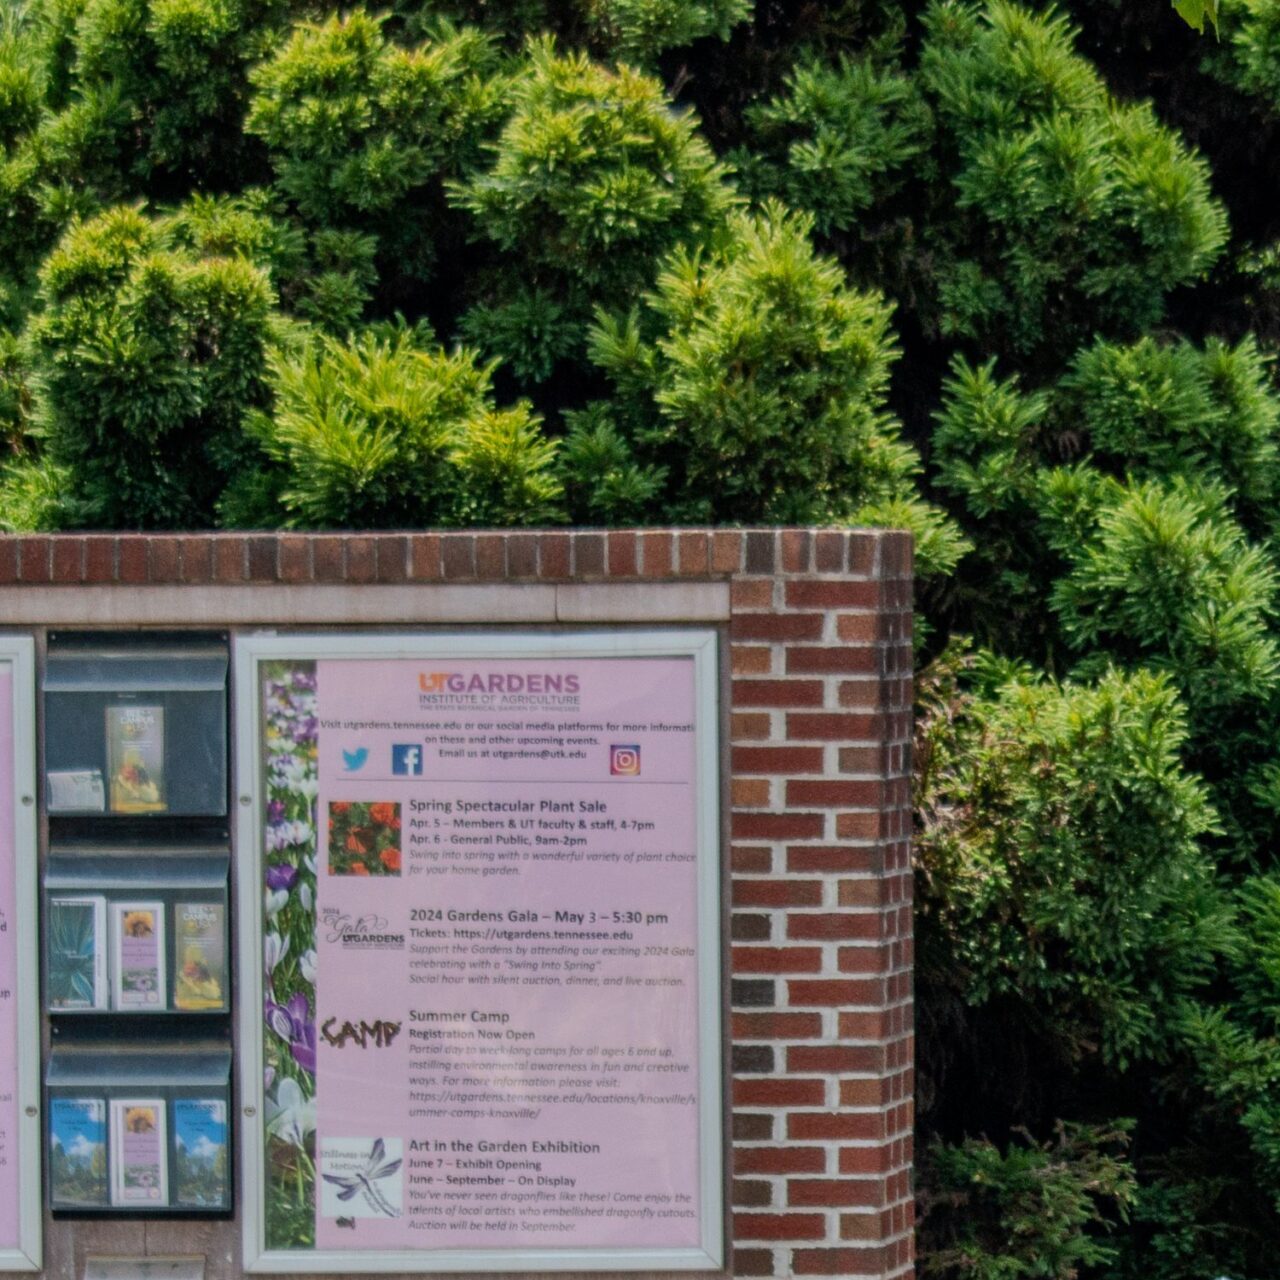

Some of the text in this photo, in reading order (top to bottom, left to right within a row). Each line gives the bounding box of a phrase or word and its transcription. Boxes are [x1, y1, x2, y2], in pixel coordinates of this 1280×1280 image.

[419, 692, 581, 705] INSTITUTE OF AGRICULTURE
[321, 720, 342, 729] Visit
[343, 721, 462, 730] utgardens.tennessee.edu
[464, 722, 475, 730] or
[496, 721, 524, 731] social
[525, 722, 556, 731] media
[557, 722, 604, 732] platforms
[605, 722, 620, 732] for
[622, 724, 648, 732] more
[425, 736, 438, 744] on
[439, 735, 466, 744] these
[468, 735, 487, 744] and
[488, 736, 515, 744] other
[517, 737, 565, 746] upcoming
[438, 749, 587, 759] Email us at utgardens@utk.edu
[409, 799, 607, 814] Spring Spectacular Plant Sale
[434, 818, 441, 828] 5
[452, 819, 505, 829] Members
[508, 819, 517, 829] &
[519, 819, 535, 829] UT
[538, 819, 576, 830] faculty
[578, 819, 587, 829] &
[590, 820, 617, 830] staff,
[620, 820, 655, 830] 4-7pm
[409, 834, 588, 846] Apr. 6 General Public, 9am-2pm
[410, 849, 440, 861] Swing
[441, 851, 462, 860] into
[463, 851, 496, 862] spring
[497, 850, 521, 860] with
[521, 852, 531, 861] a
[531, 851, 585, 861] wonderful
[586, 852, 622, 862] variety
[623, 851, 636, 863] of
[637, 852, 663, 862] plant
[410, 909, 669, 925] 2024 Gardens Gala May 3 5:30 pm
[453, 929, 634, 940] https://utgardens.tennessee.edu
[409, 944, 450, 955] Support
[451, 943, 470, 954] the
[470, 944, 513, 954] Gardens
[515, 945, 529, 956] by
[530, 945, 580, 956] attending
[581, 947, 601, 956] our
[601, 946, 642, 957] exciting
[642, 946, 670, 956] 2024
[671, 946, 696, 957] Gala
[409, 960, 467, 969] celebrating
[468, 959, 492, 969] with
[492, 960, 501, 970] a
[540, 961, 562, 970] Into
[409, 974, 685, 987] Social hour with silent auction, dinner, and live auction.
[409, 1010, 510, 1023] Summer Camp
[320, 1016, 402, 1049] CAMP
[408, 1029, 536, 1040] Registration Now Open
[409, 1044, 443, 1054] Partial
[445, 1045, 463, 1056] day
[534, 1047, 567, 1056] camps
[568, 1045, 585, 1057] for
[585, 1045, 600, 1056] all
[600, 1048, 626, 1058] ages
[627, 1047, 635, 1056] 6
[636, 1047, 658, 1057] and
[658, 1048, 674, 1058] up,
[408, 1060, 690, 1074] instilling environmental awareness in fun and creative
[442, 1075, 461, 1086] For
[462, 1077, 491, 1086] more
[493, 1077, 556, 1087] information
[558, 1079, 594, 1088] please
[409, 1140, 601, 1153] Art in the Garden Exhibition
[408, 1158, 542, 1172] June 7 Exhibit Opening
[408, 1175, 577, 1187] June September On Display
[443, 1192, 473, 1200] never
[474, 1192, 499, 1201] seen
[500, 1191, 557, 1203] dragonflies
[558, 1192, 577, 1201] like
[578, 1192, 611, 1202] these!
[612, 1192, 643, 1202] Come
[644, 1193, 673, 1204] enjoy
[674, 1193, 692, 1203] the
[408, 1206, 443, 1215] talents
[444, 1204, 458, 1217] of
[458, 1205, 482, 1216] local
[485, 1207, 516, 1216] artists
[518, 1206, 542, 1216] who
[542, 1206, 605, 1217] embellished
[605, 1207, 656, 1219] dragonfly
